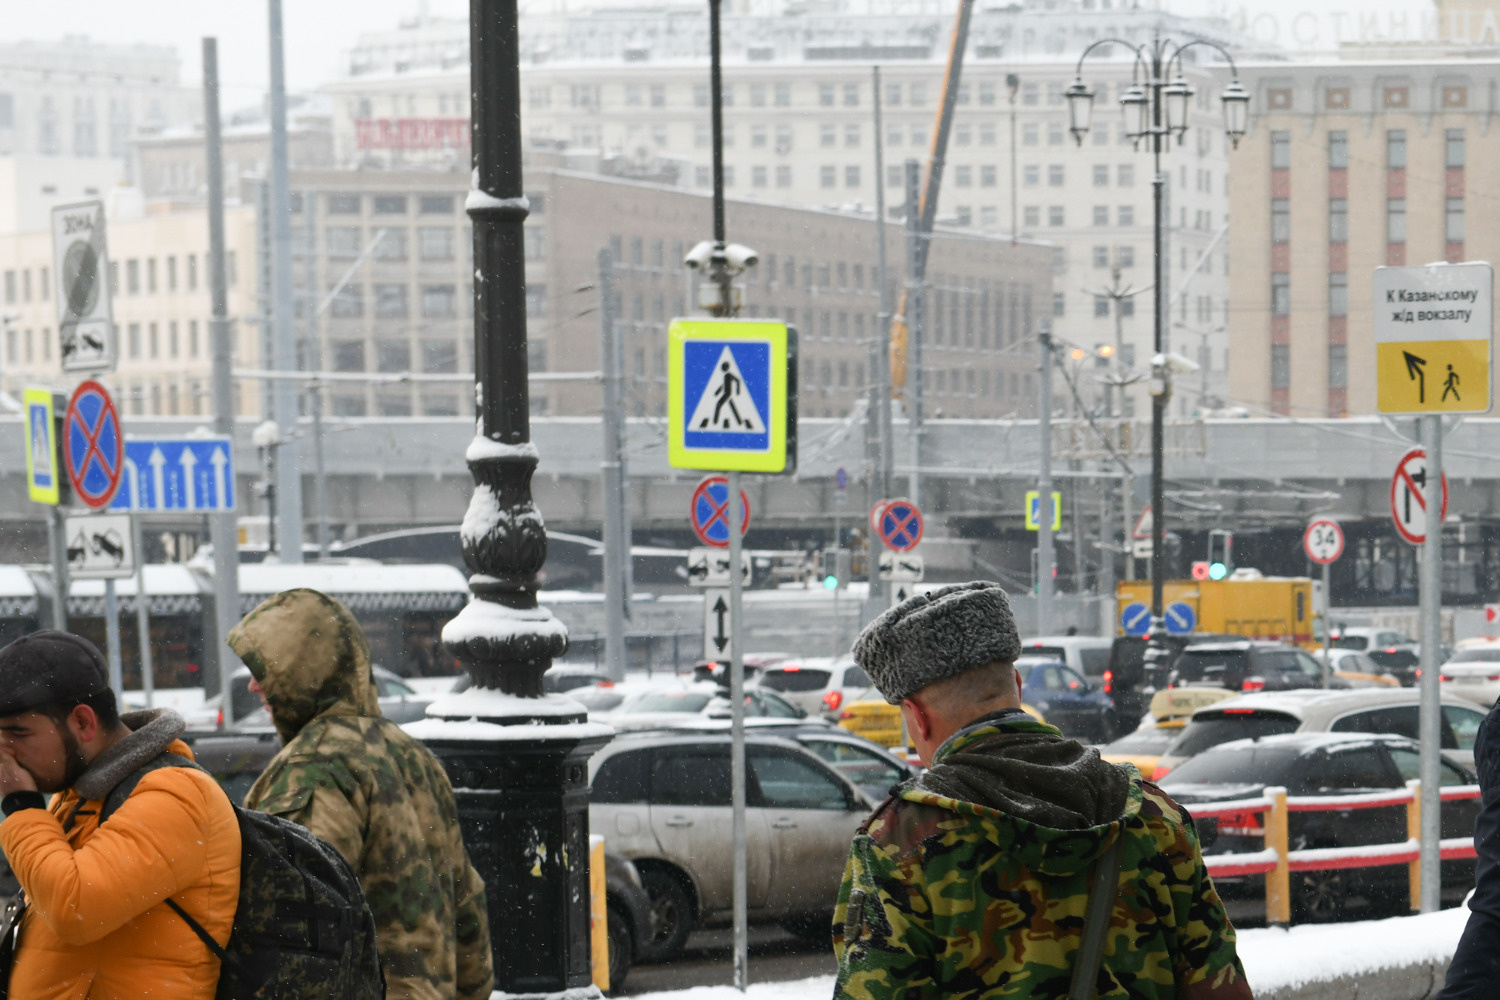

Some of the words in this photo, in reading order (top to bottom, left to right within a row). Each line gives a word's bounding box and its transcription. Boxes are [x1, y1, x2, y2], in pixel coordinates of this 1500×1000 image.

[1386, 289, 1395, 302] К
[1398, 288, 1478, 303] Казанскому
[1392, 308, 1414, 323] ж/д
[1418, 308, 1472, 323] вокзалу
